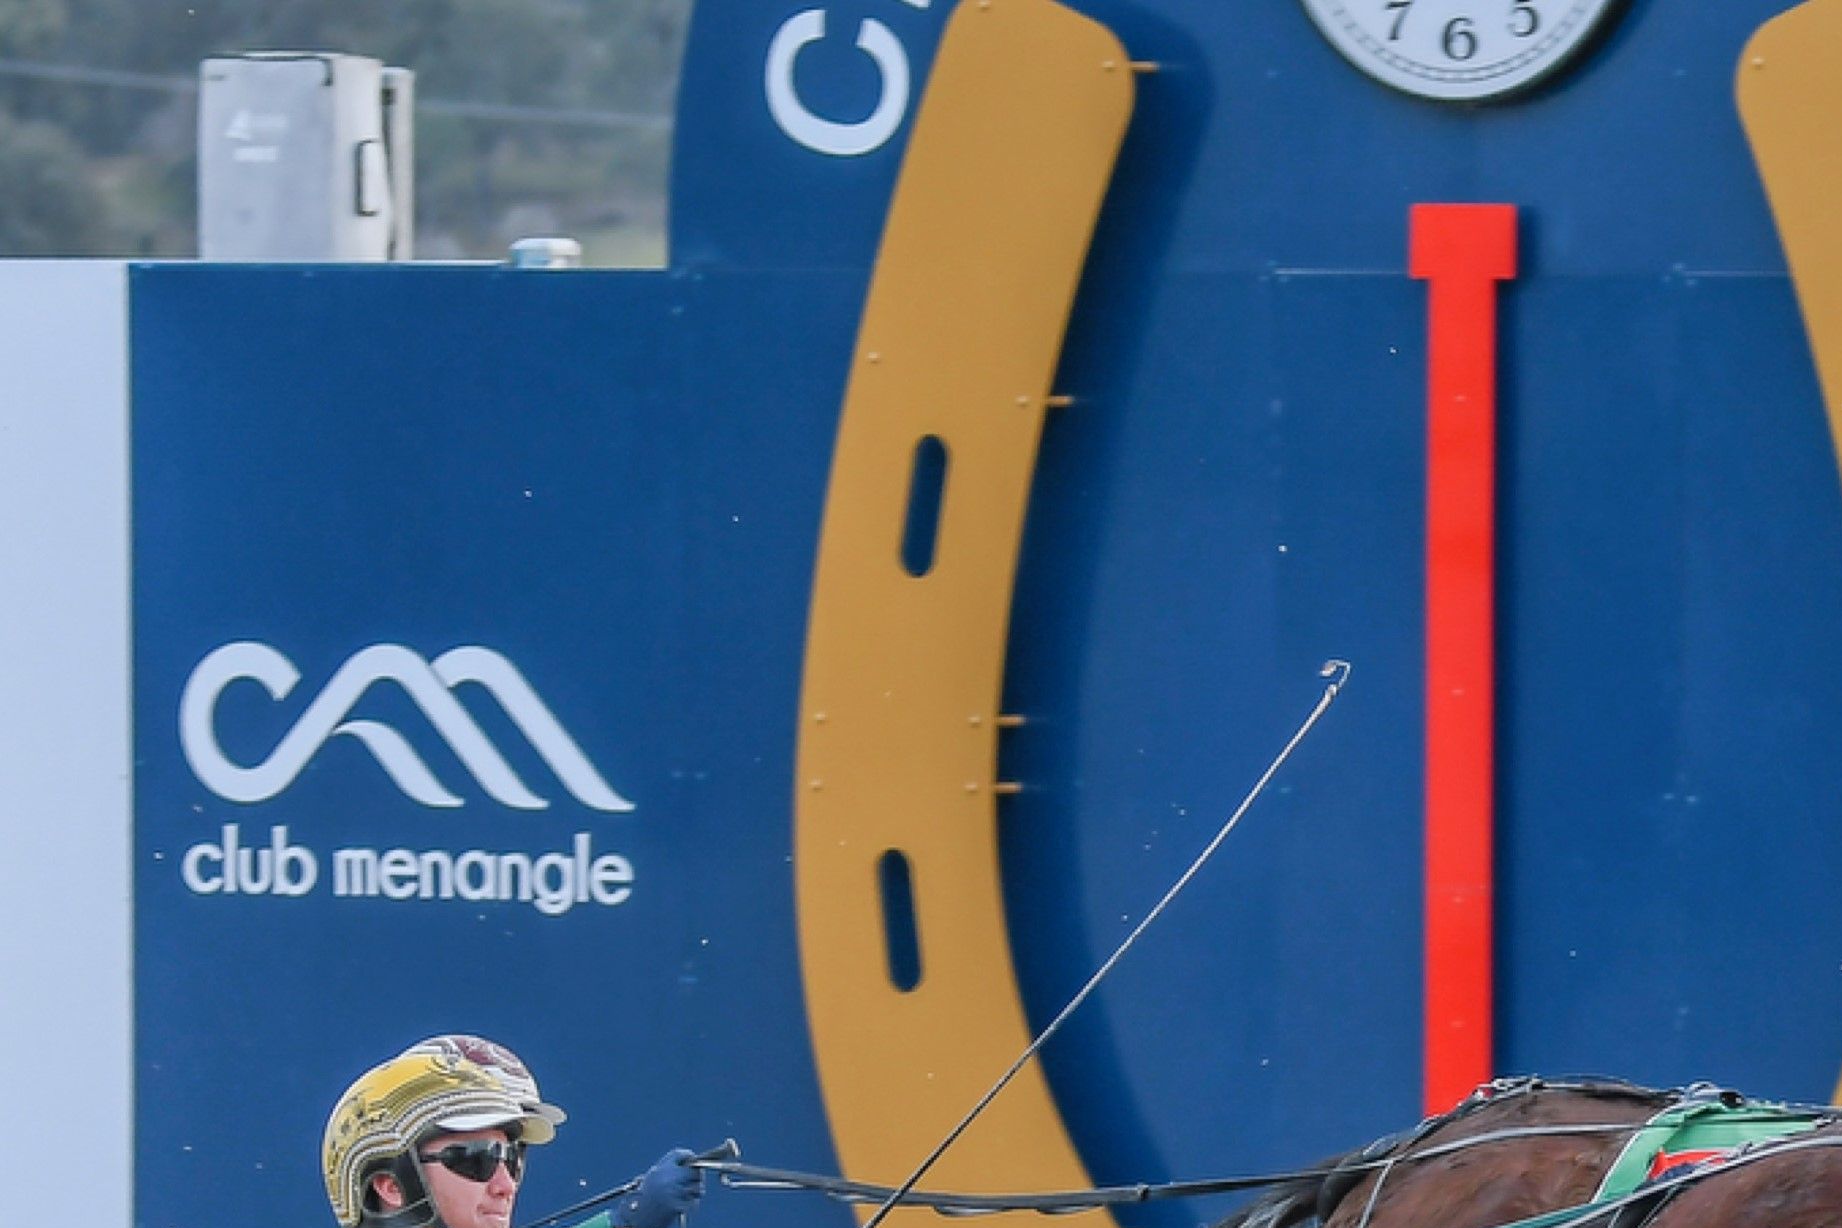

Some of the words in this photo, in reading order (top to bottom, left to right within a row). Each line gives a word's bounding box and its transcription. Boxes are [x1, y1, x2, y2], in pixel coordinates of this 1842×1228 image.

[1384, 0, 1413, 41] 7
[1441, 16, 1478, 61] 6
[1508, 0, 1541, 38] 5
[182, 823, 318, 896] club
[332, 832, 635, 915] menangle
